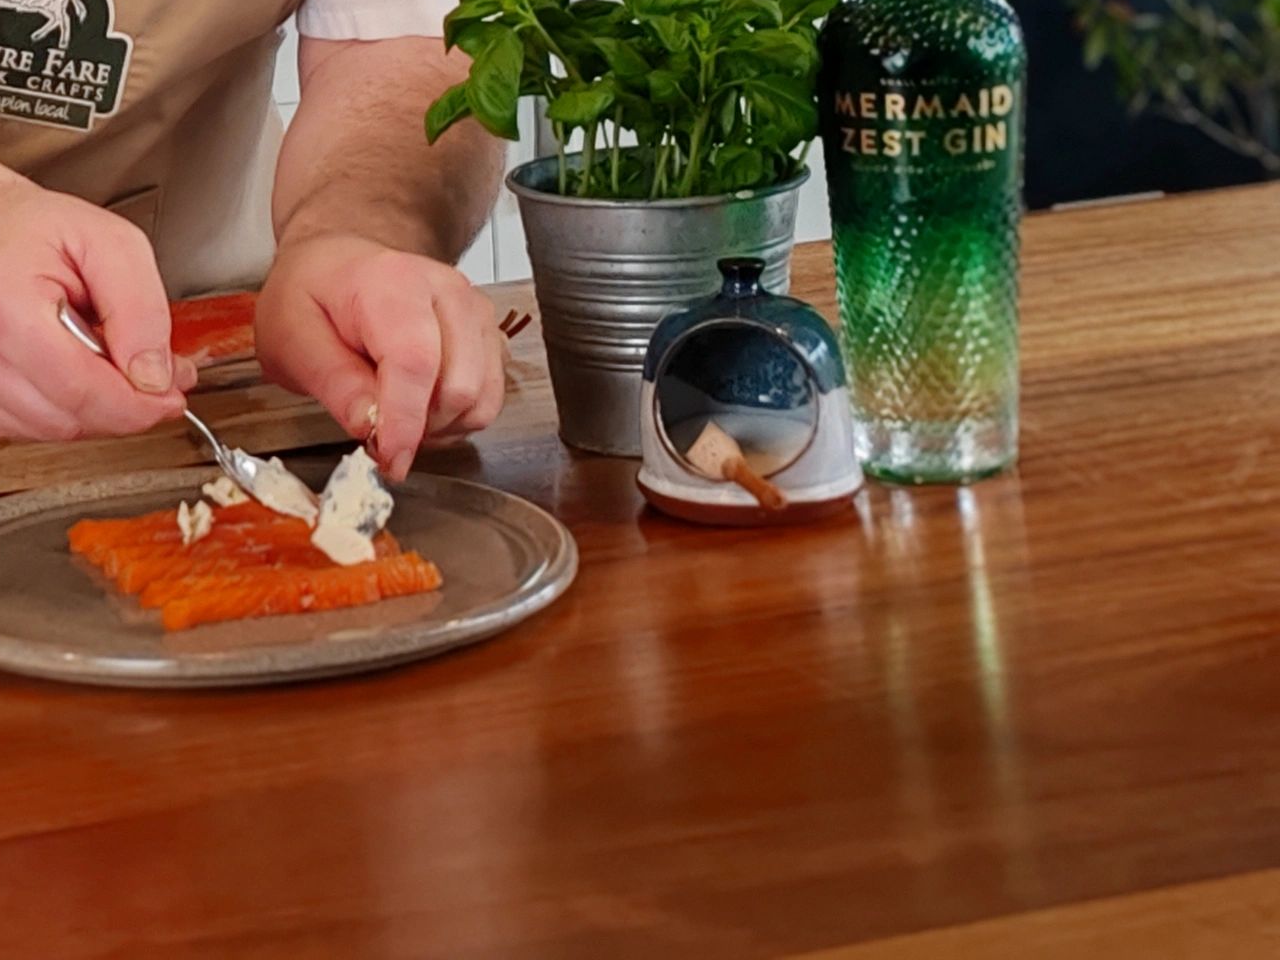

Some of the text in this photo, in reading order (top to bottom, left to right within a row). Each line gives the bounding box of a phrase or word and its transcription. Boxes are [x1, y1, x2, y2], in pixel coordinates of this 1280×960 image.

[41, 46, 112, 86] FARE
[26, 75, 105, 103] CRAFTS
[834, 84, 1014, 121] MERMAID
[34, 101, 70, 120] local
[840, 121, 1007, 157] ZEST GIN
